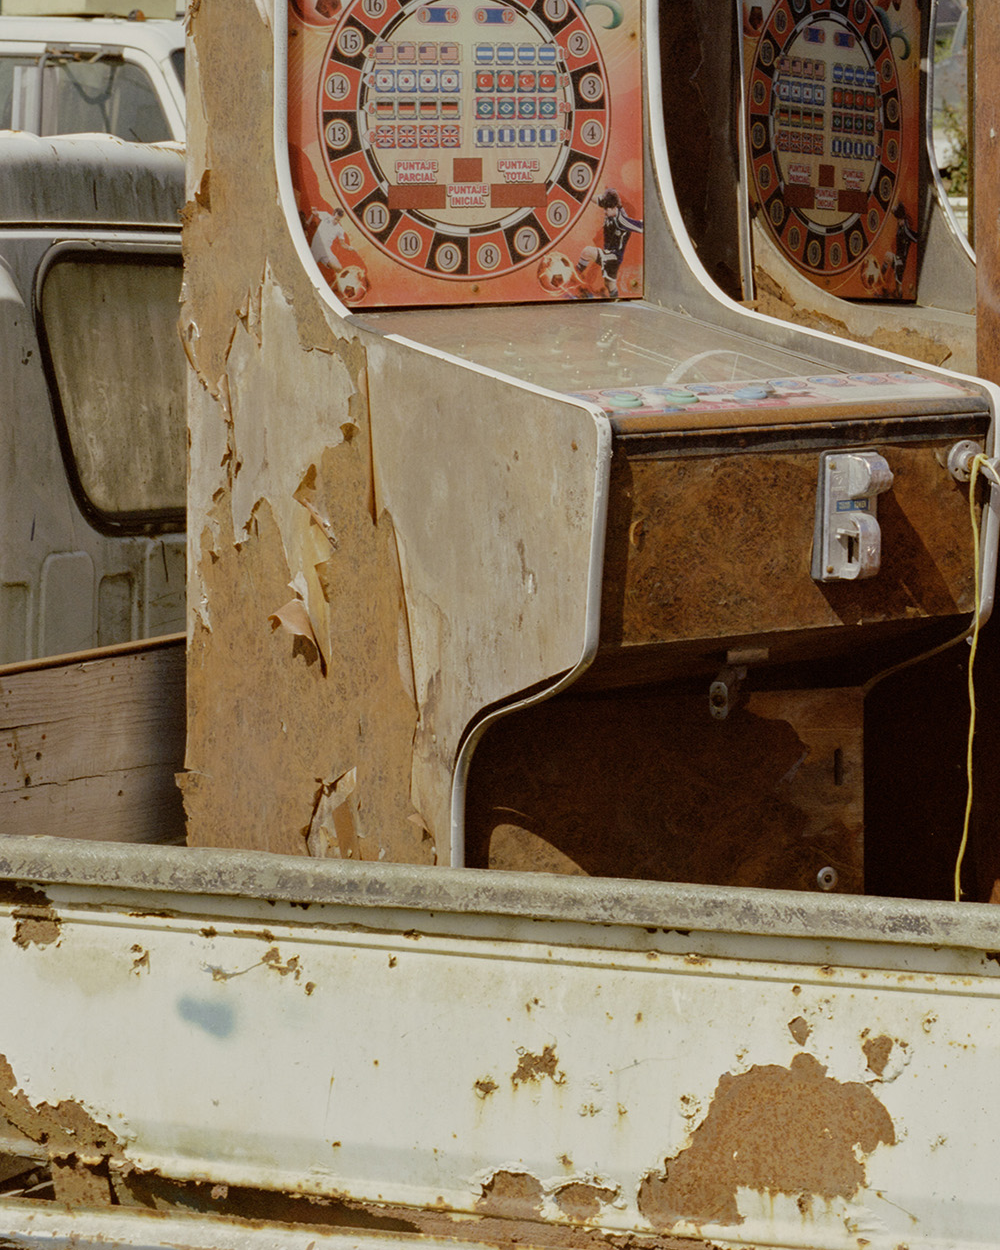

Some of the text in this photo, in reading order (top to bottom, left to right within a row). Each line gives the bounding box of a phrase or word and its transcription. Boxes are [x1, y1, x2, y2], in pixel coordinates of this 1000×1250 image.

[422, 10, 457, 20] 1 14
[553, 1, 560, 15] 1
[478, 11, 514, 21] 6 12
[343, 33, 358, 50] 15
[575, 36, 584, 51] 2
[330, 79, 346, 94] 14
[588, 80, 596, 95] 3
[331, 127, 346, 142] 13
[587, 126, 596, 140] 4
[396, 161, 437, 170] PUNTAJE
[499, 160, 538, 169] PUNTAJE
[344, 171, 359, 187] 12
[398, 173, 435, 182] PARCIAL
[505, 172, 532, 181] TOTAL
[577, 169, 585, 184] 5
[448, 185, 488, 194] PUNTAJE
[451, 196, 484, 205] INICIAL
[370, 210, 383, 224] 11
[553, 206, 562, 222] 6
[403, 235, 418, 251] 10
[523, 235, 531, 250] 7
[790, 231, 799, 245] 10
[444, 249, 453, 266] 9
[485, 248, 494, 264] 8
